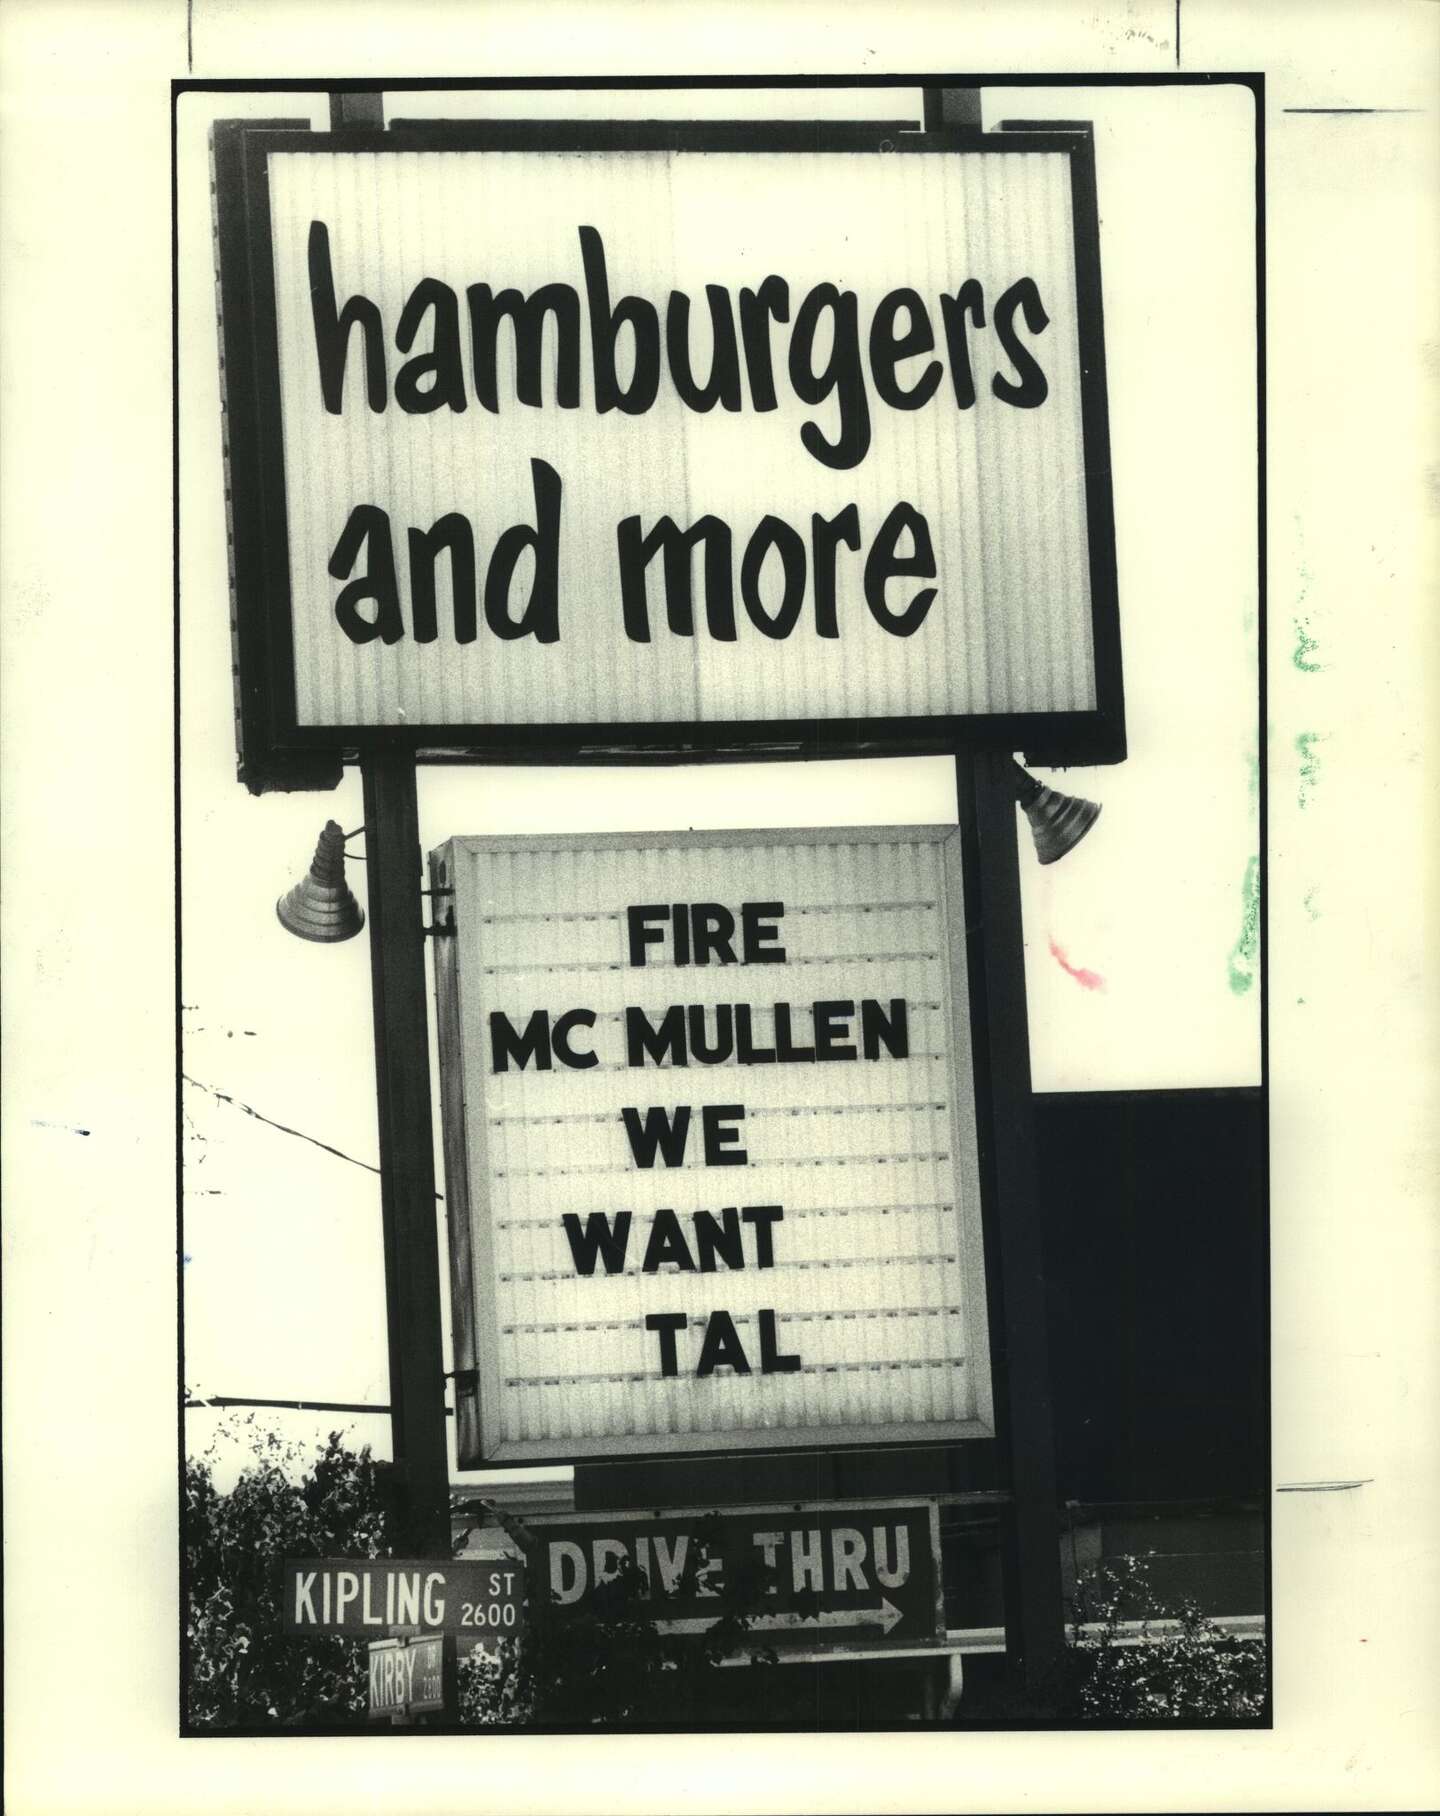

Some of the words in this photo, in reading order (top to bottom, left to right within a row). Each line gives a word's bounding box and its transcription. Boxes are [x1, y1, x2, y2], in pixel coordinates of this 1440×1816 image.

[309, 221, 1049, 470] hamburgers
[328, 458, 561, 645] and
[618, 502, 937, 642] more
[628, 902, 786, 966] FIRE
[490, 1009, 598, 1073] MC
[626, 999, 908, 1067] MULLEN
[620, 1105, 747, 1168] WE
[563, 1206, 783, 1275] WANT
[646, 1310, 801, 1378] TAL
[754, 1526, 909, 1594] THRU
[296, 1572, 445, 1626] KIPLING
[489, 1574, 515, 1596] ST
[461, 1603, 516, 1626] 2600
[369, 1648, 417, 1708] KIRBY
